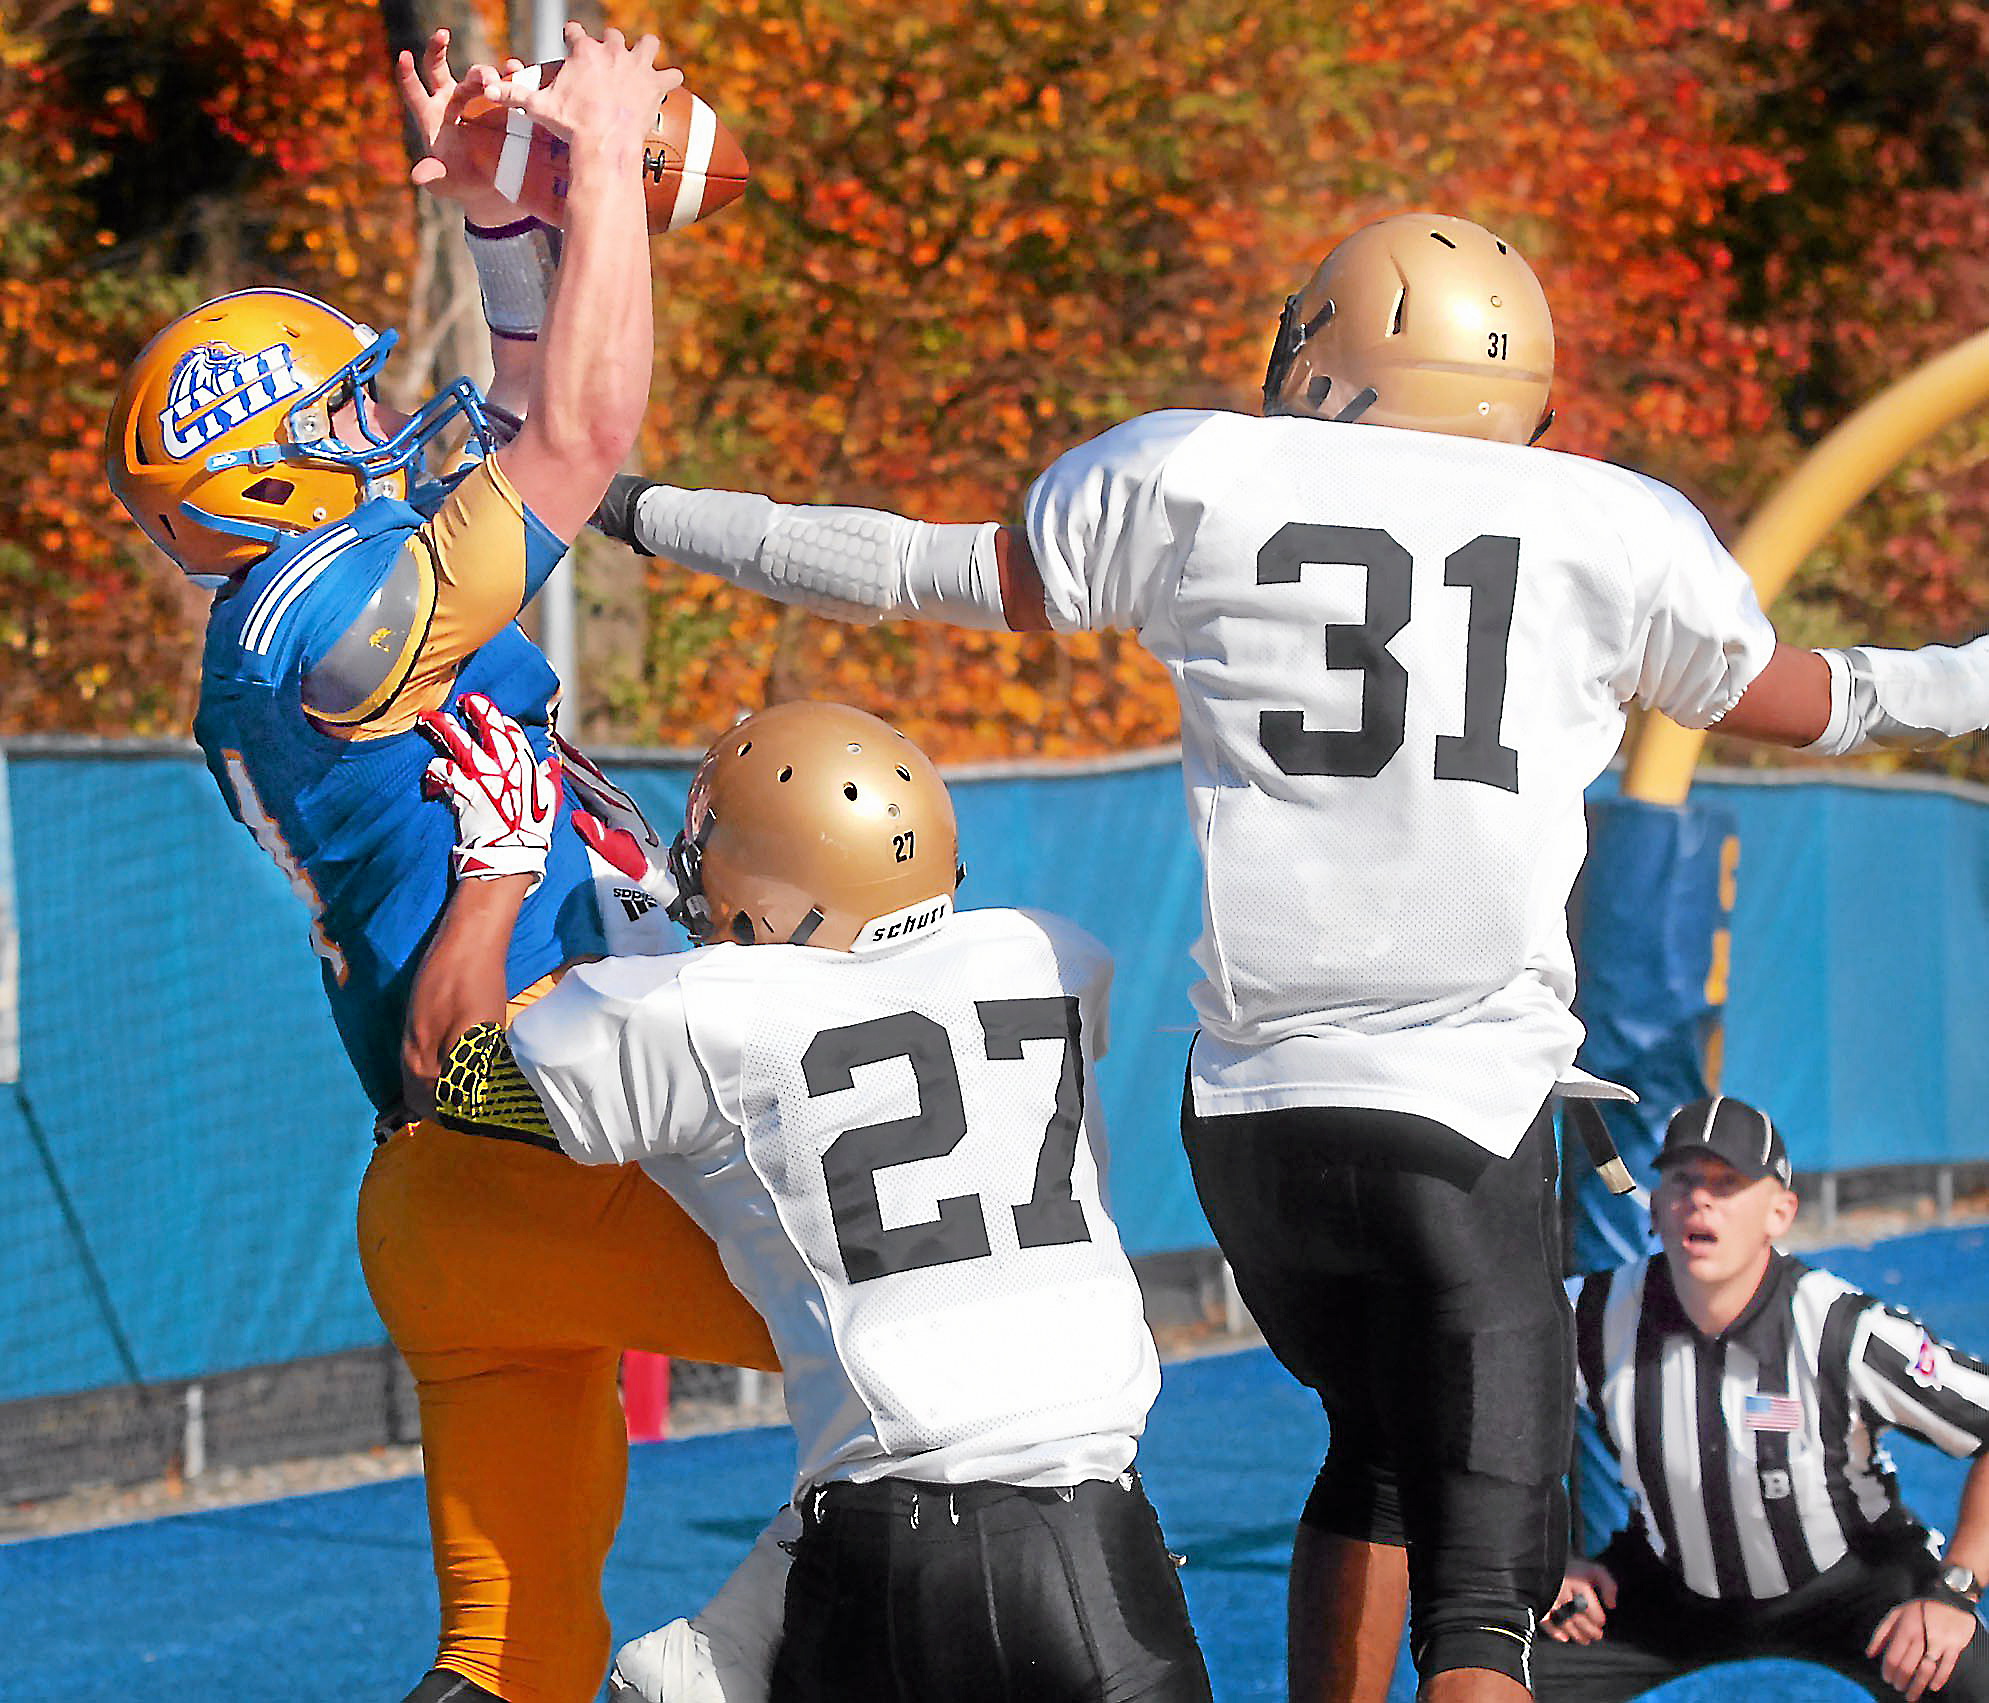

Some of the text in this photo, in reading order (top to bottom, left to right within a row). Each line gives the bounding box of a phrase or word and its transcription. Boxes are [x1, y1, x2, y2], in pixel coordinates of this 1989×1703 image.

[1487, 332, 1507, 361] 31
[1256, 521, 1521, 794] 31
[892, 830, 915, 863] 27
[800, 996, 1092, 1284] 27
